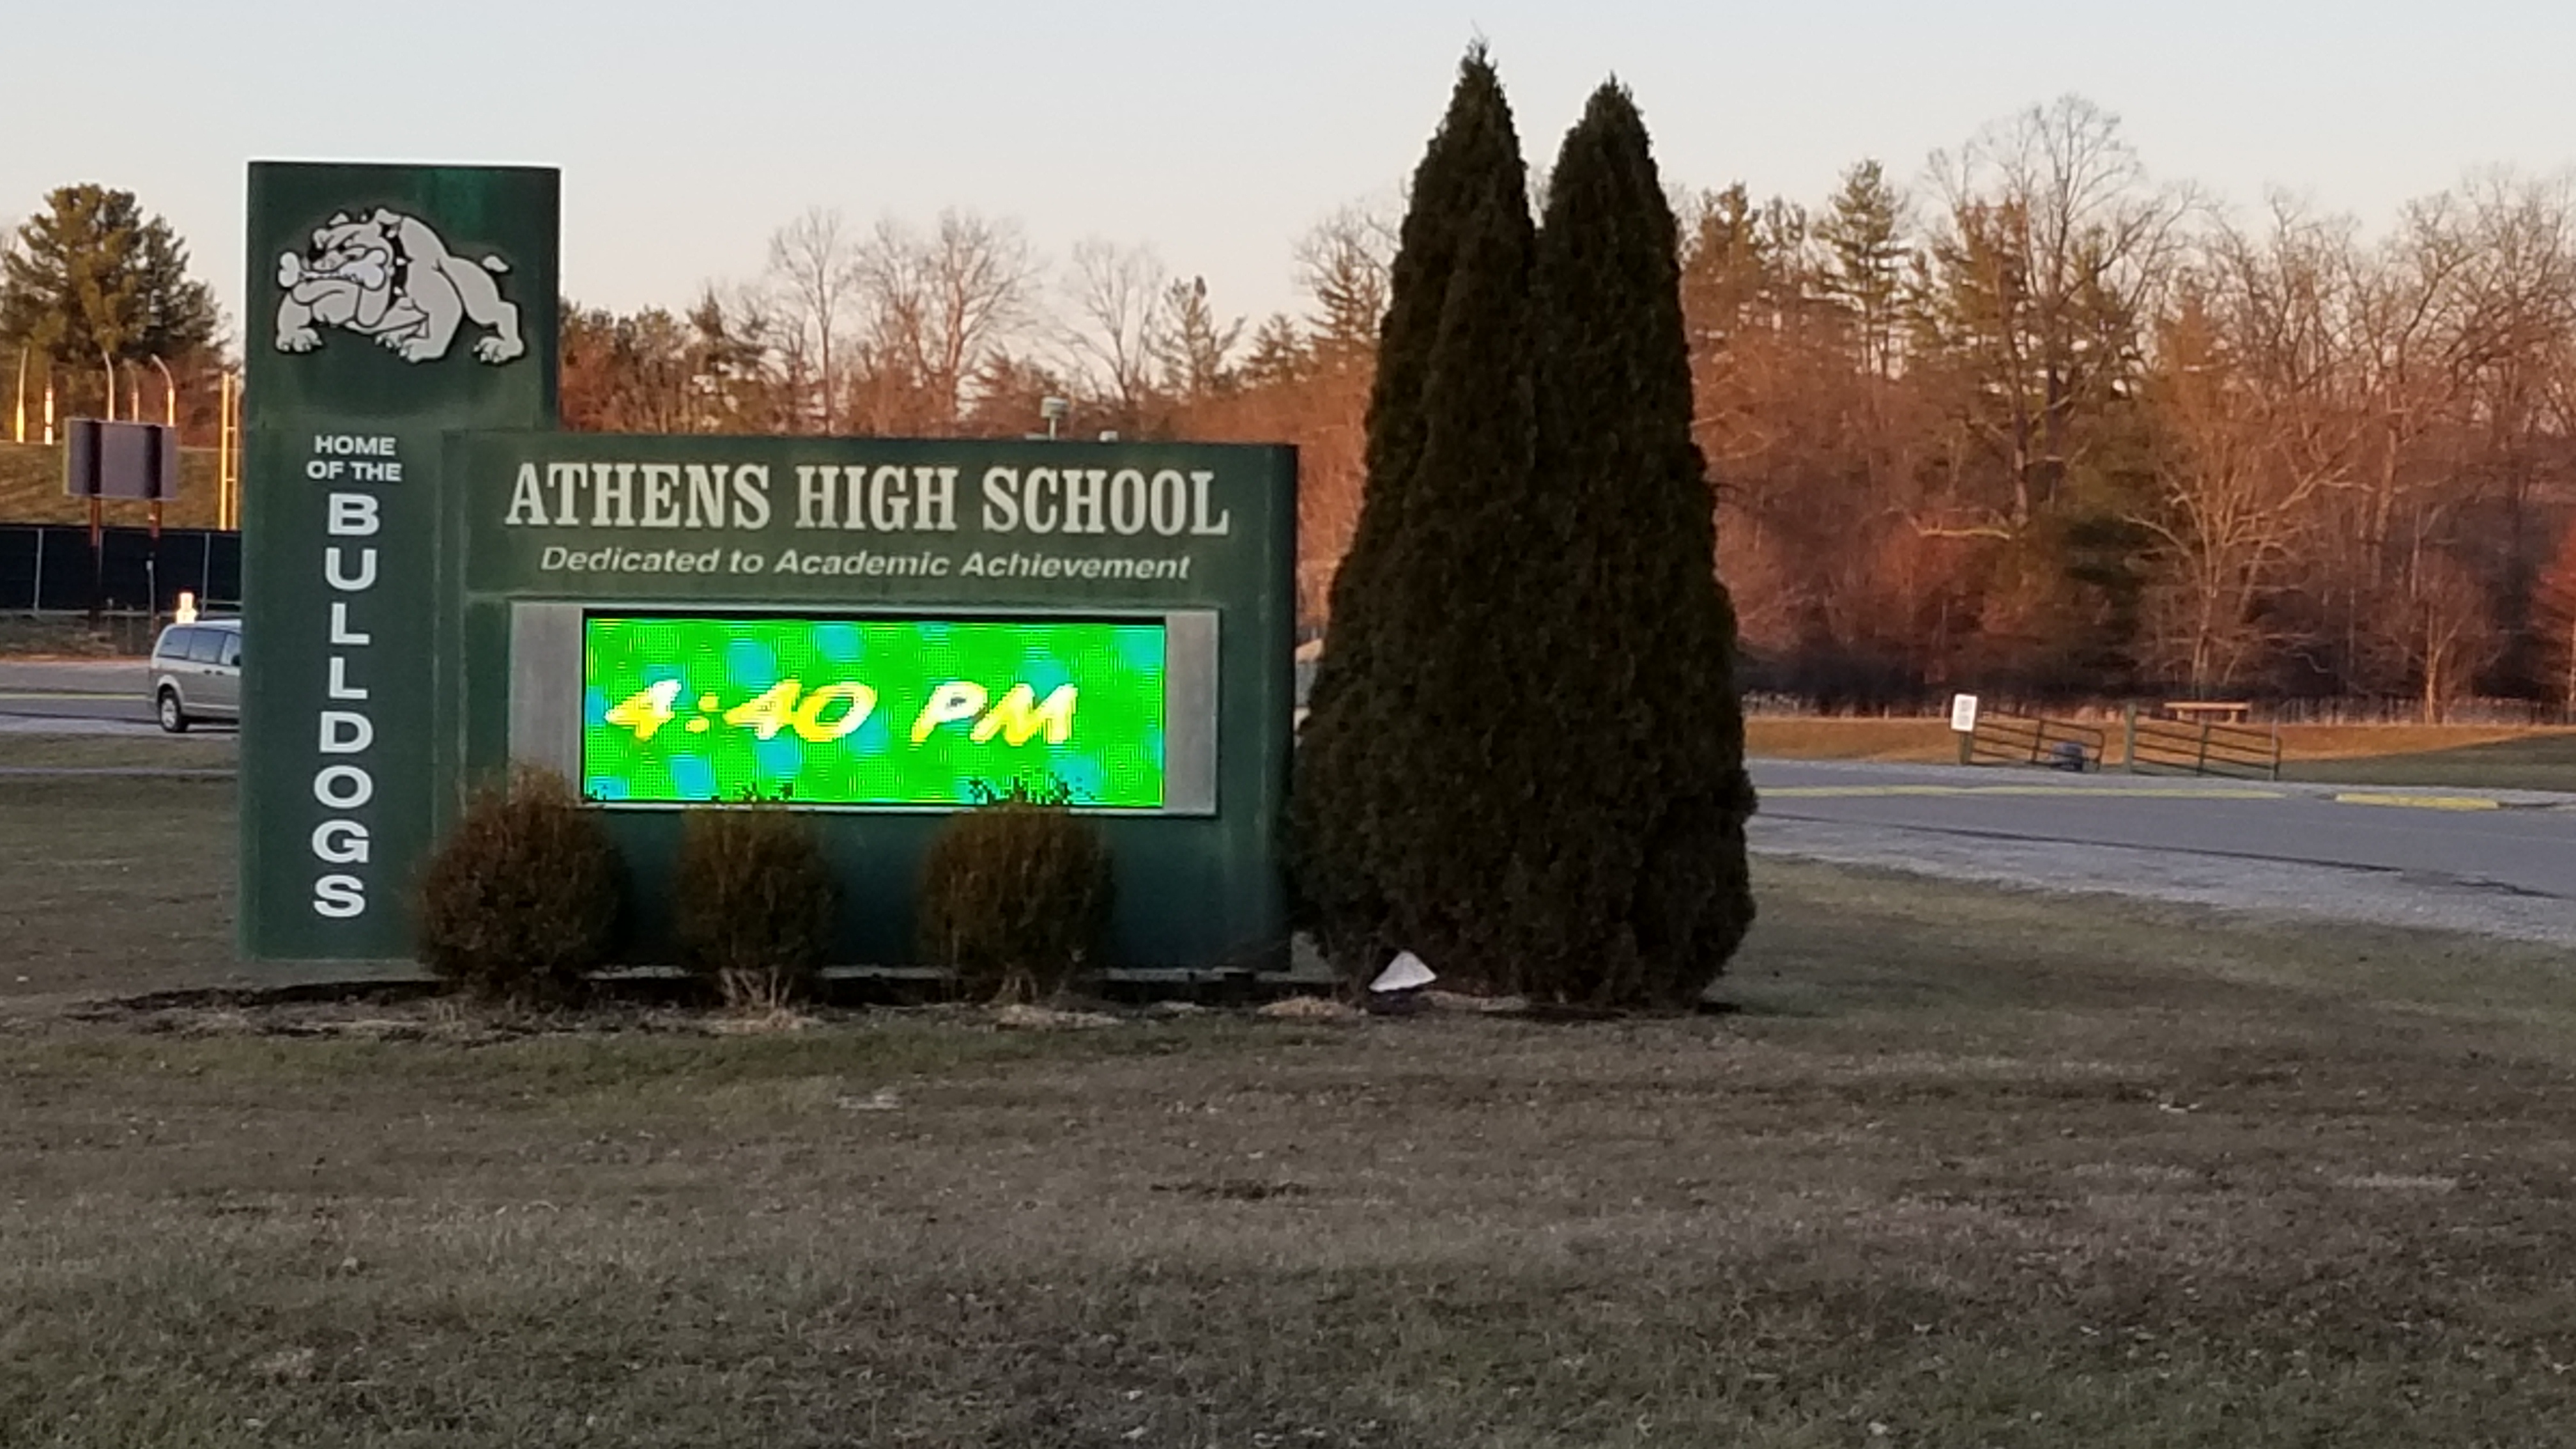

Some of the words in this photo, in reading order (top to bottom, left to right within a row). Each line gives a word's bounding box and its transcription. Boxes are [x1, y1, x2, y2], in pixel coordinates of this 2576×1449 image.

[314, 435, 395, 456] HOME
[306, 460, 344, 479] OF
[349, 461, 402, 482] THE
[505, 463, 770, 530] ATHENS
[795, 465, 958, 532] HIGH
[983, 466, 1229, 535] SCHOOL
[541, 546, 721, 572] Dedicated
[730, 549, 764, 573] to
[774, 549, 950, 576] Academic
[960, 551, 1190, 579] Achievement
[312, 493, 379, 917] BULLDOGS
[605, 678, 877, 742] 4:40
[910, 681, 1078, 746] PM
